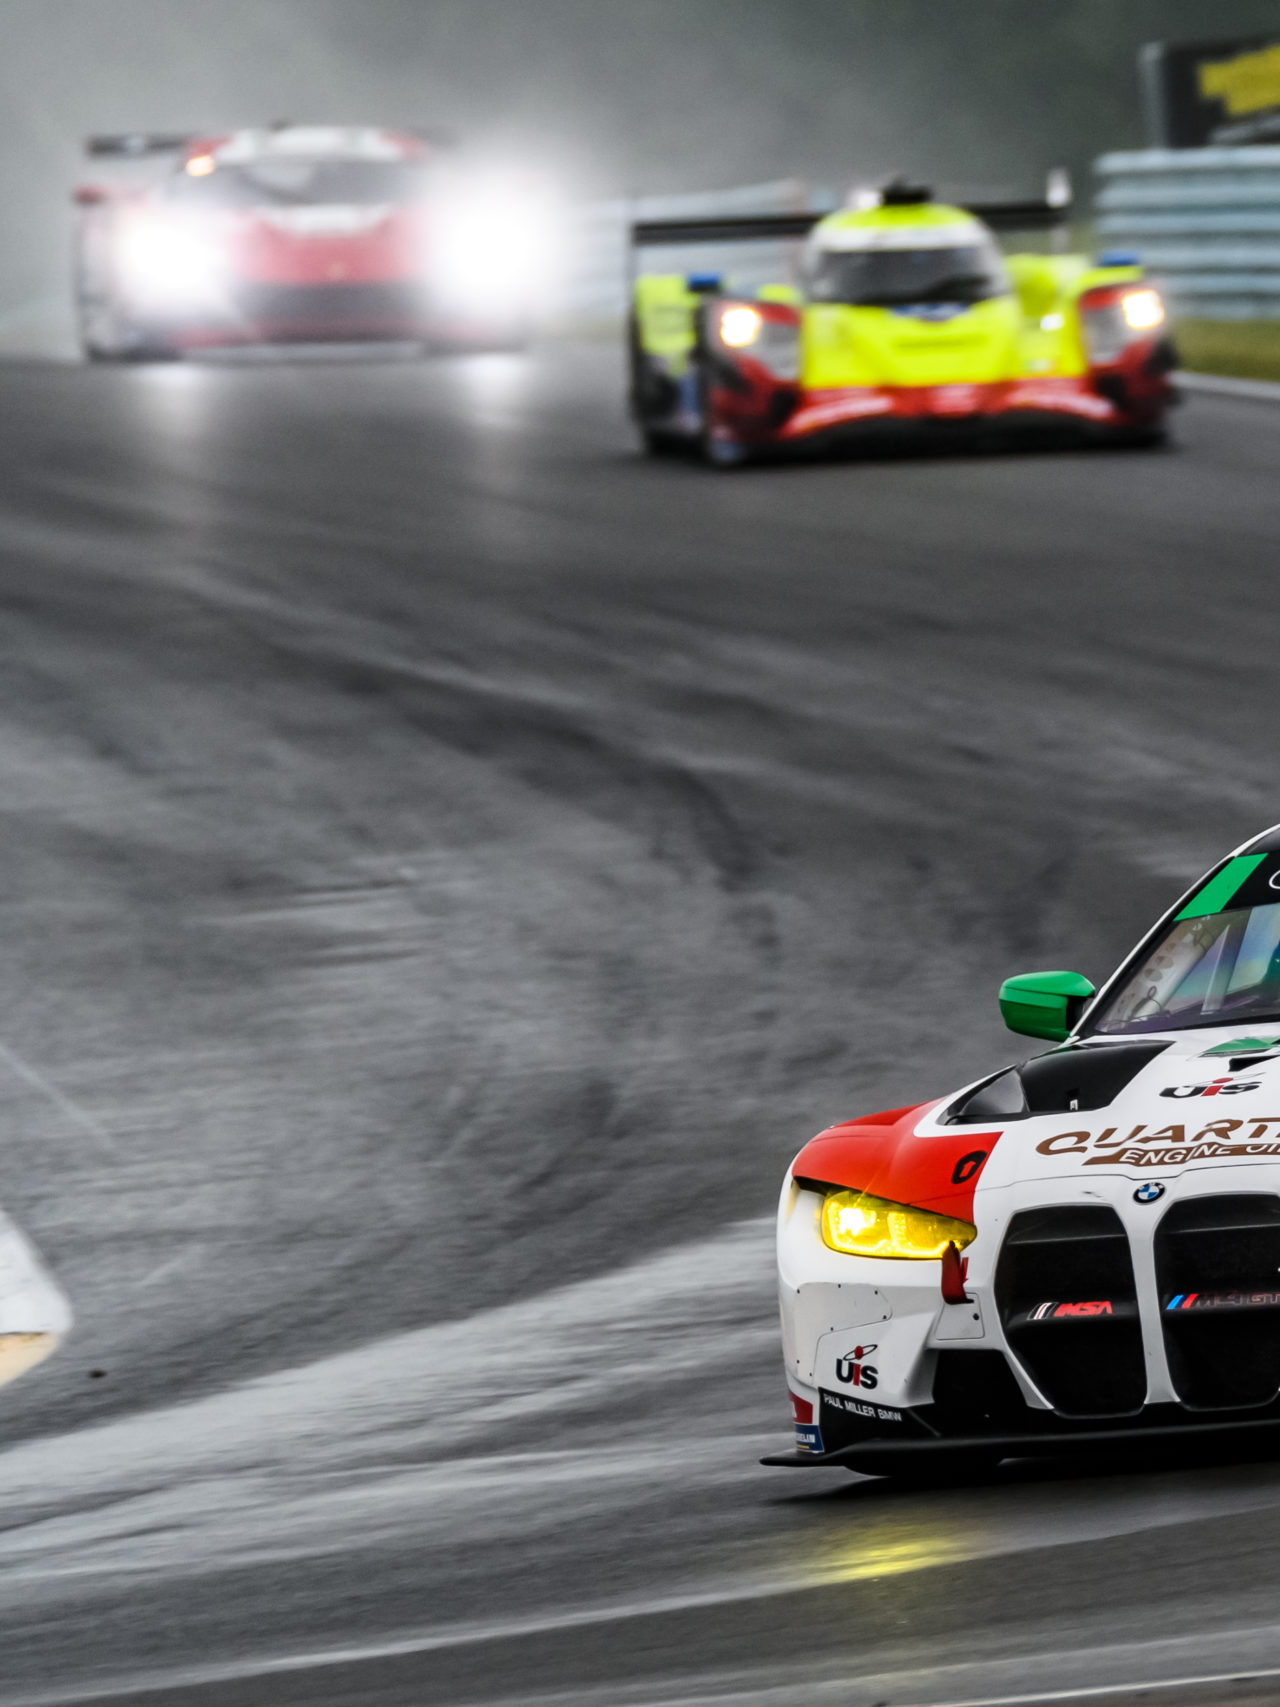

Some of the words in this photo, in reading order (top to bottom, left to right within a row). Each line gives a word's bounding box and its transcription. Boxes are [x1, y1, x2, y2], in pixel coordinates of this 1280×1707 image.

[1119, 1144, 1234, 1165] ENGINE
[823, 1393, 844, 1410] PAUL
[844, 1400, 876, 1418] MILLER
[877, 1408, 902, 1422] BMW
